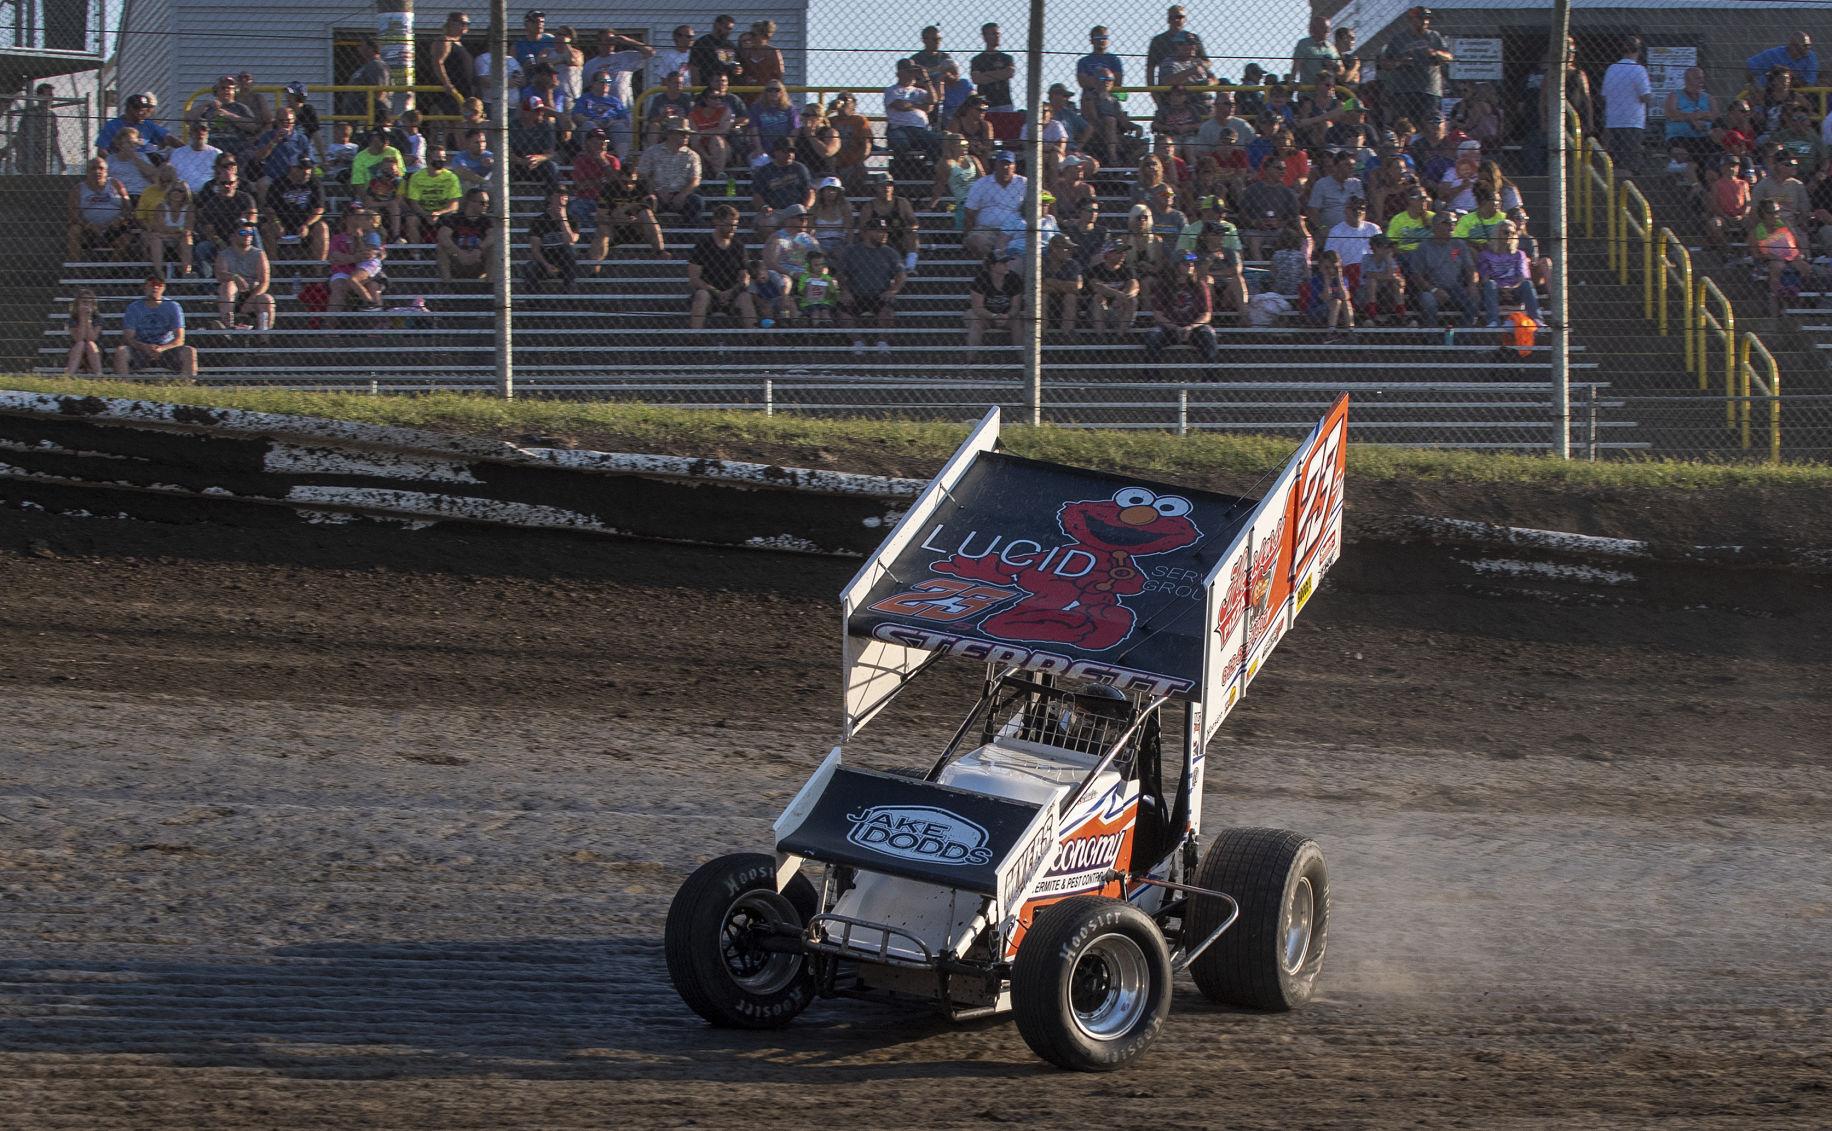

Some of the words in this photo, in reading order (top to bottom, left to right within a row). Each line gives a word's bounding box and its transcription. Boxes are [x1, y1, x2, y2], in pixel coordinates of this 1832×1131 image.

[921, 524, 1097, 578] LUCID
[867, 578, 1024, 622] 23
[847, 808, 951, 840] JAKE
[857, 825, 993, 866] DODDS
[1032, 879, 1061, 894] ERMITE
[1066, 876, 1082, 889] PEST
